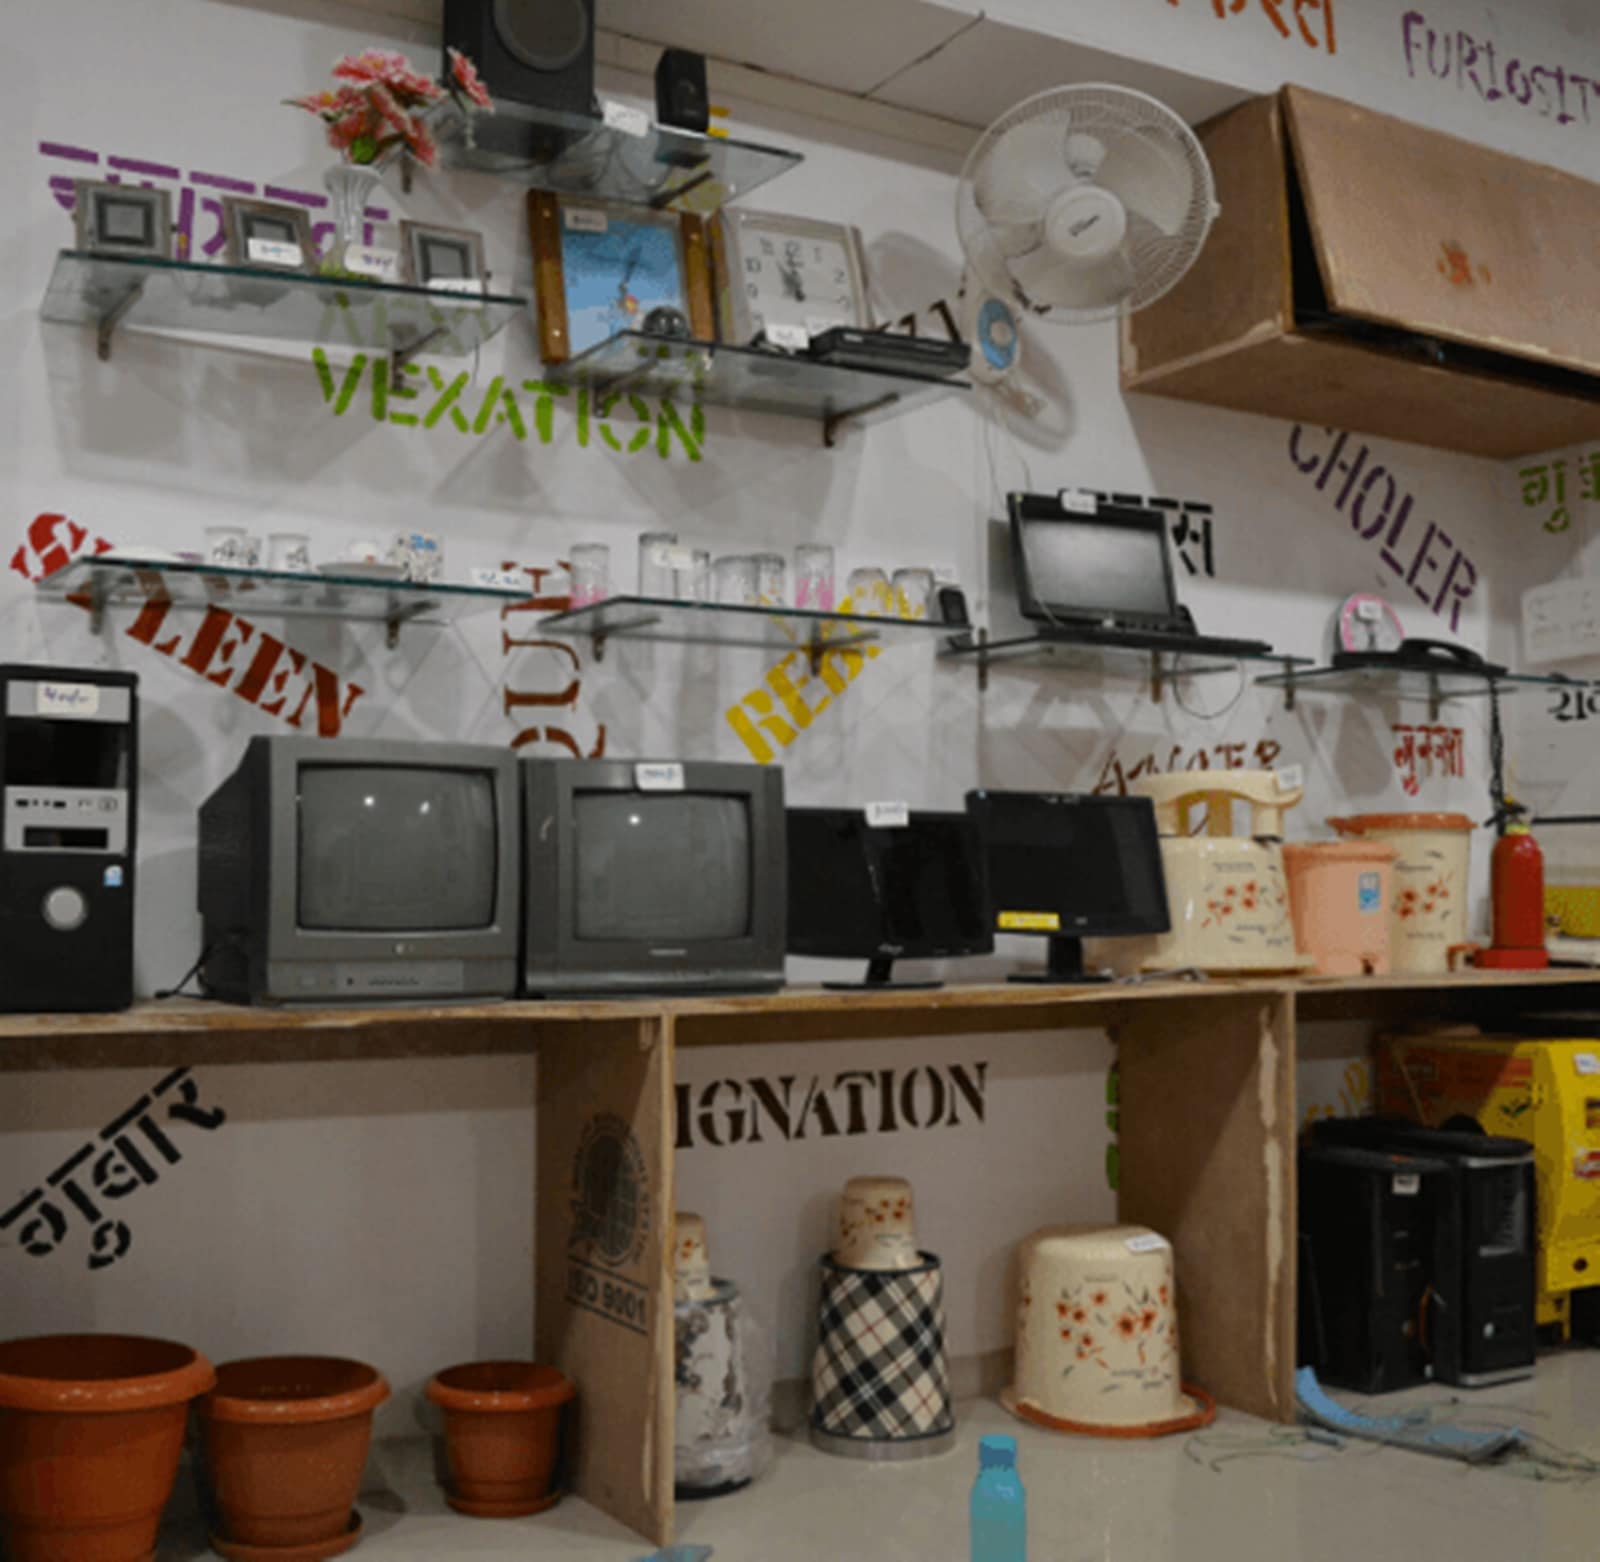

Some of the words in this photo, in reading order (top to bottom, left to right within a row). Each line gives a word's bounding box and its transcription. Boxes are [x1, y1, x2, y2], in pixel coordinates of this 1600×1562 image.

[1402, 11, 1600, 125] FURIOSIT
[312, 346, 706, 462] VEXATION
[9, 512, 366, 739] SLEEN
